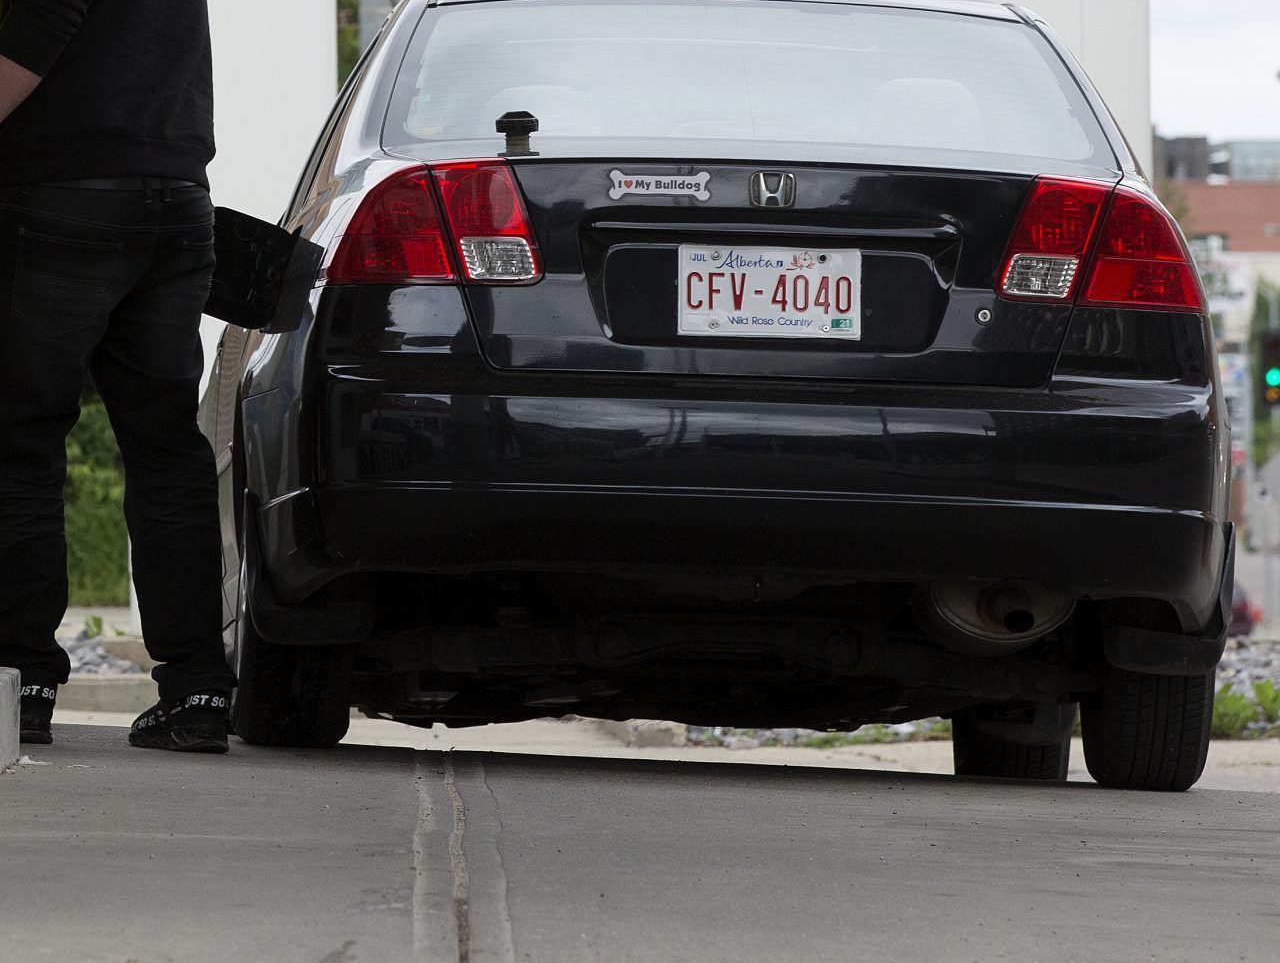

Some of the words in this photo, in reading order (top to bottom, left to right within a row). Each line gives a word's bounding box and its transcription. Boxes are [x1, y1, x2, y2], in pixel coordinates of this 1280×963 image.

[635, 179, 651, 190] My
[654, 179, 701, 192] Bulldog
[691, 253, 707, 262] JUL
[715, 250, 776, 269] Alberta
[686, 271, 853, 315] CFV-4040
[727, 316, 749, 325] Wild
[751, 316, 775, 326] Rose
[779, 316, 813, 327] Country
[839, 320, 851, 328] 21
